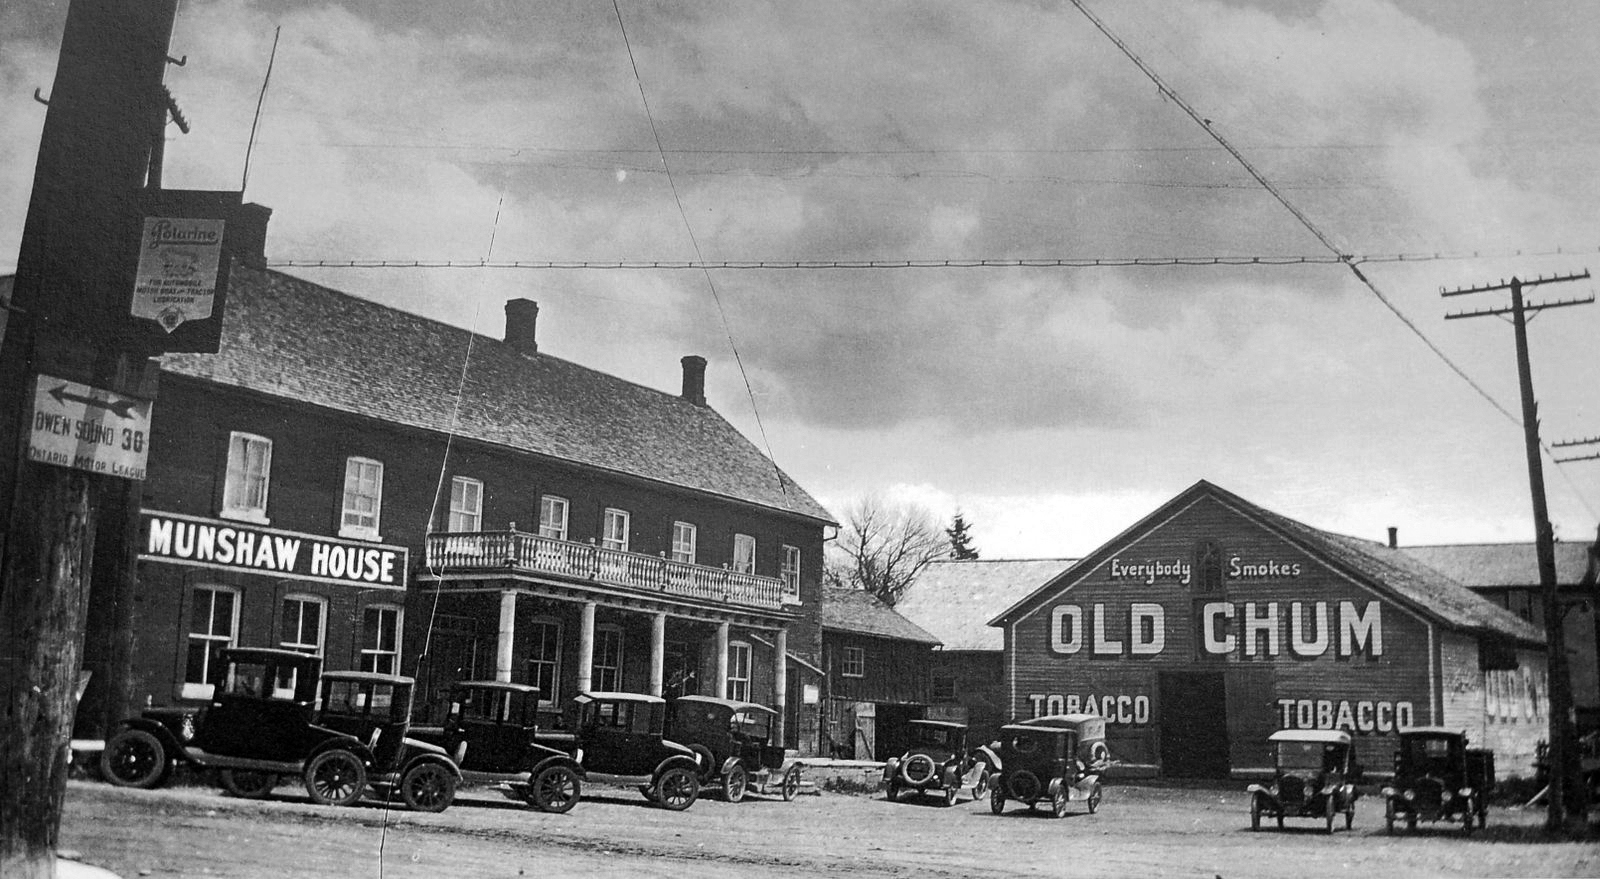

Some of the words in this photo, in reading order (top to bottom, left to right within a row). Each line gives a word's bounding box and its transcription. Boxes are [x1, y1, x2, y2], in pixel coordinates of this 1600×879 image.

[149, 220, 218, 249] Polarine
[35, 411, 71, 436] OWEN
[75, 419, 114, 446] SOUND
[112, 461, 146, 479] LEAGUE
[149, 518, 300, 572] MUNSHAW
[311, 543, 396, 582] HOUSE
[1111, 558, 1191, 584] Everybody
[1229, 556, 1301, 577] Smokes
[1051, 602, 1165, 654] OLD
[1203, 600, 1383, 656] CHUM
[1029, 694, 1149, 724] TOBACCO
[1278, 699, 1414, 733] TOBACCO
